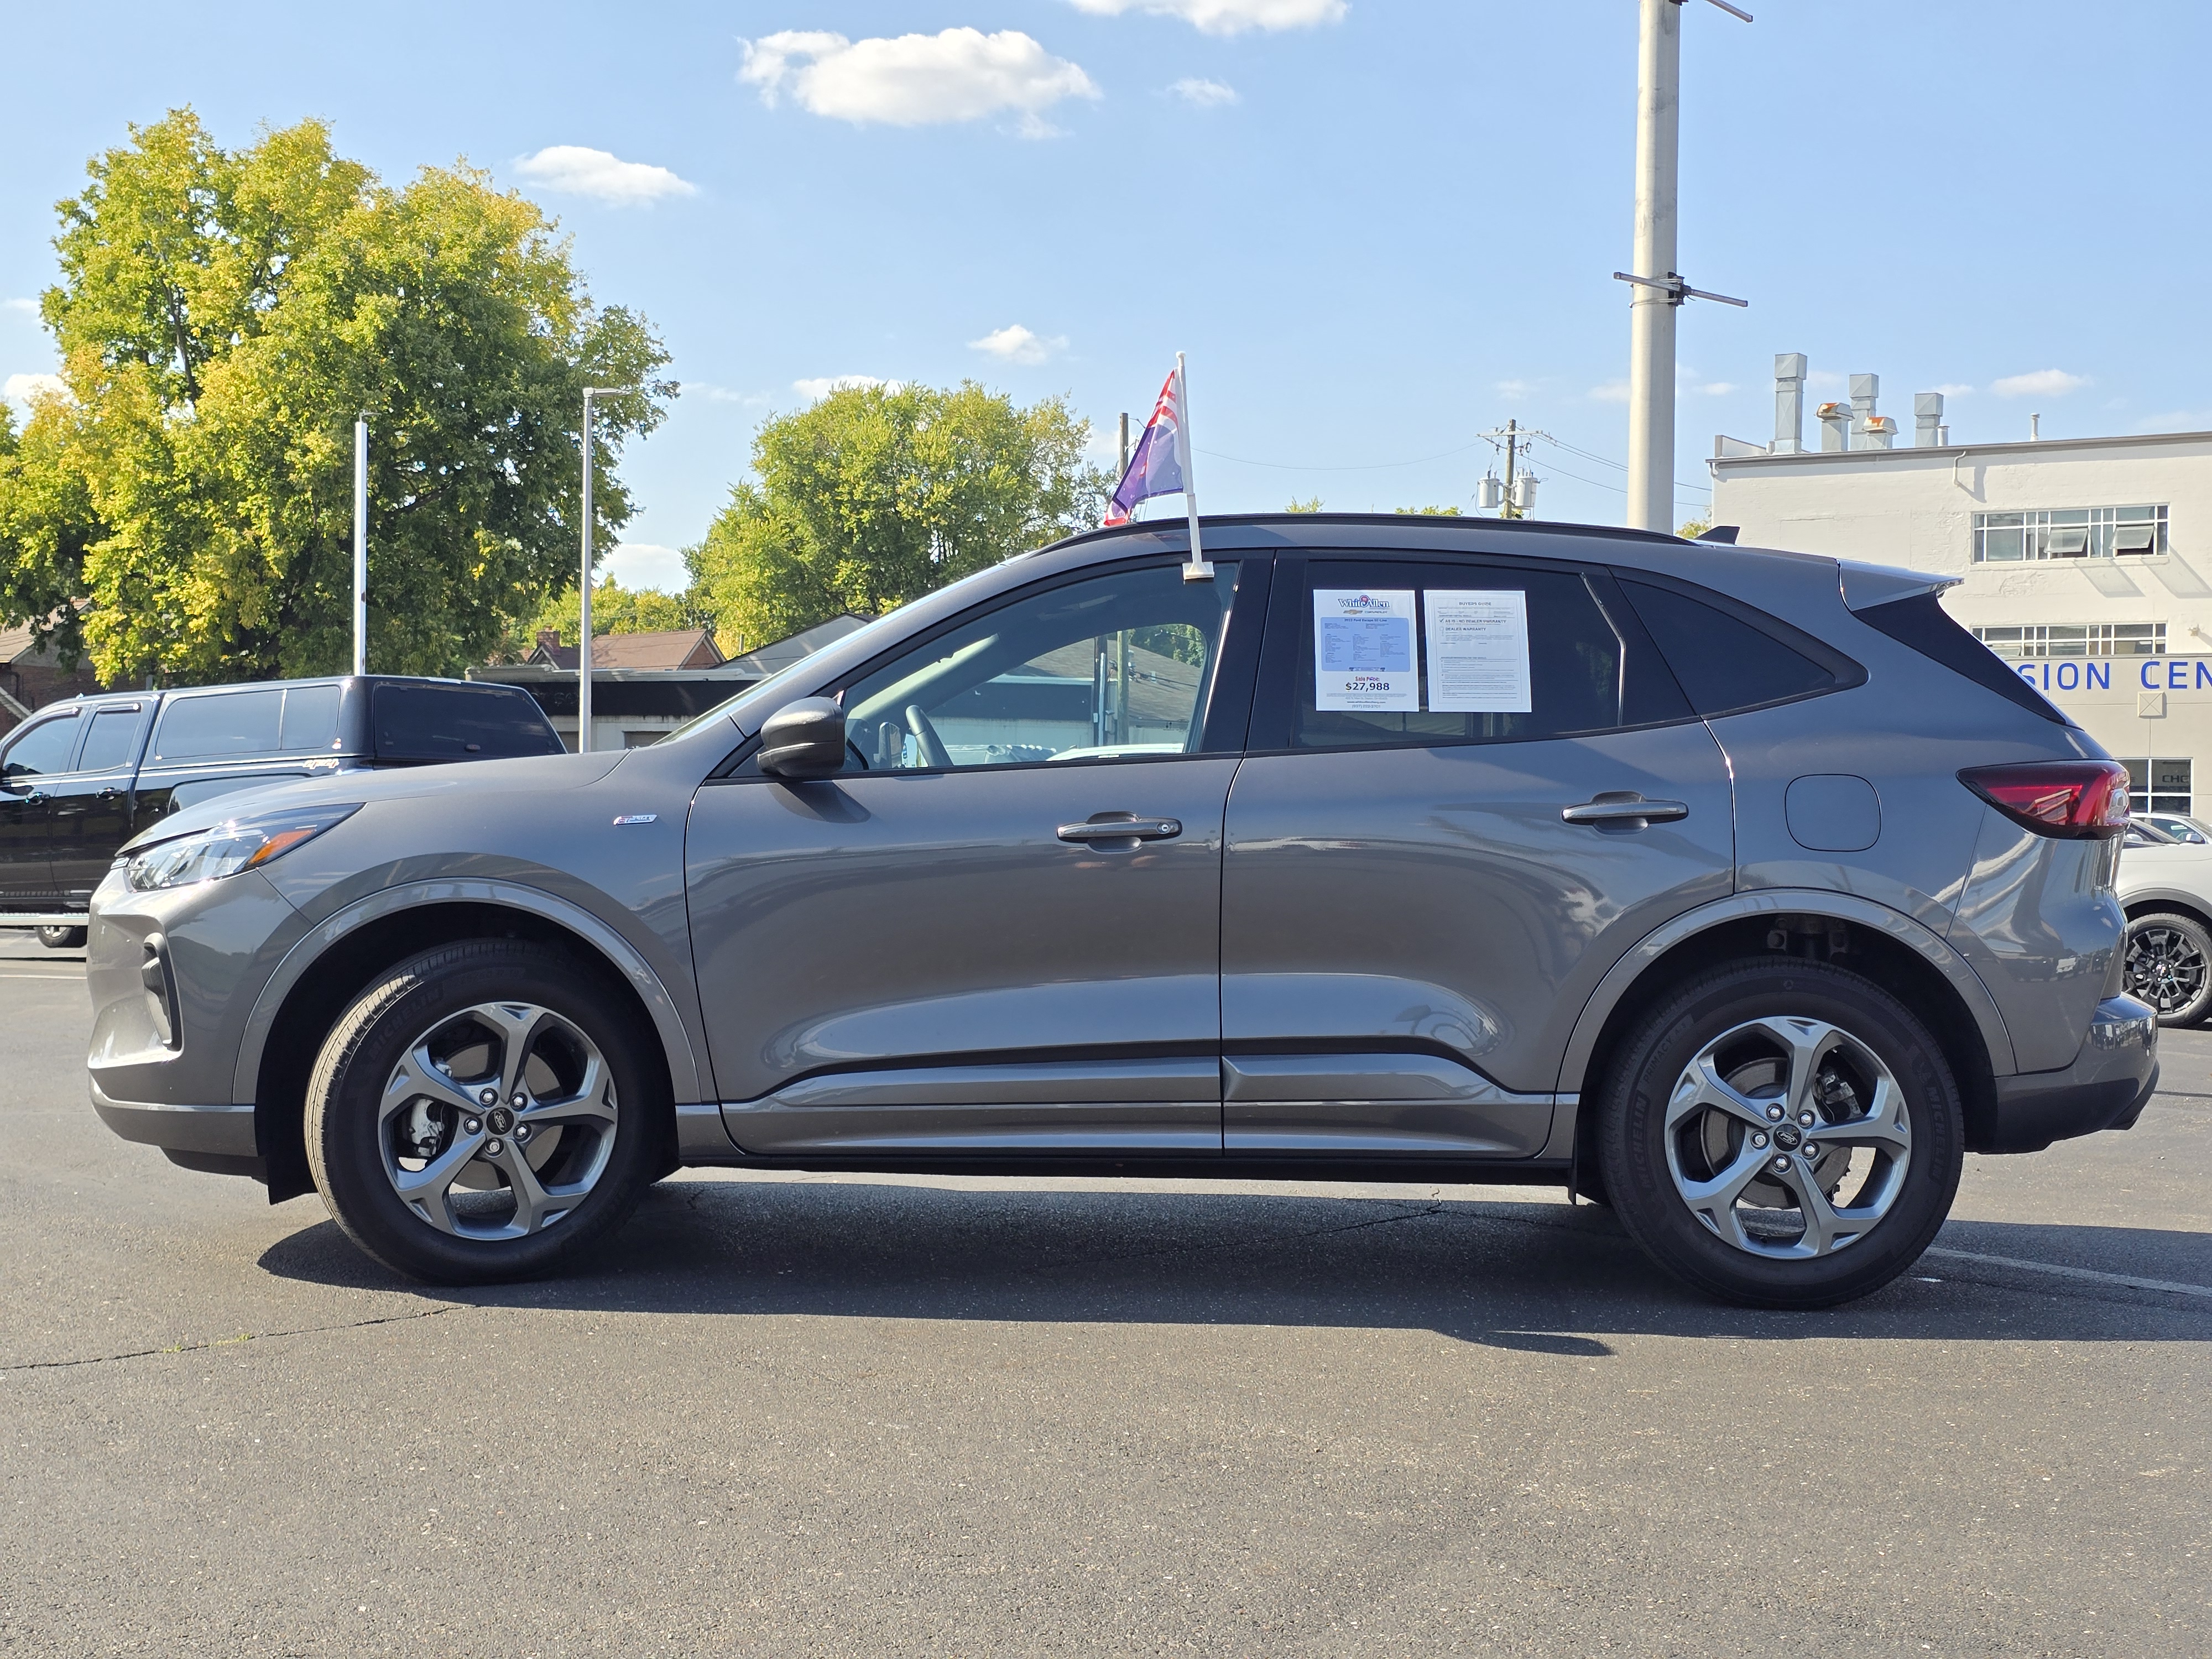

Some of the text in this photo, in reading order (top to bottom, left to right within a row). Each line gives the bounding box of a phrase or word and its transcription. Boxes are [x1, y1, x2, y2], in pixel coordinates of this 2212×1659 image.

[1338, 598, 1390, 608] White Allen
[1345, 682, 1390, 692] $27,988
[365, 987, 442, 1062] MICHELIN
[1641, 1036, 1674, 1084] PRIMACY
[1632, 1097, 1651, 1191] MICHELIN
[1926, 1083, 1945, 1179] MICHELIN
